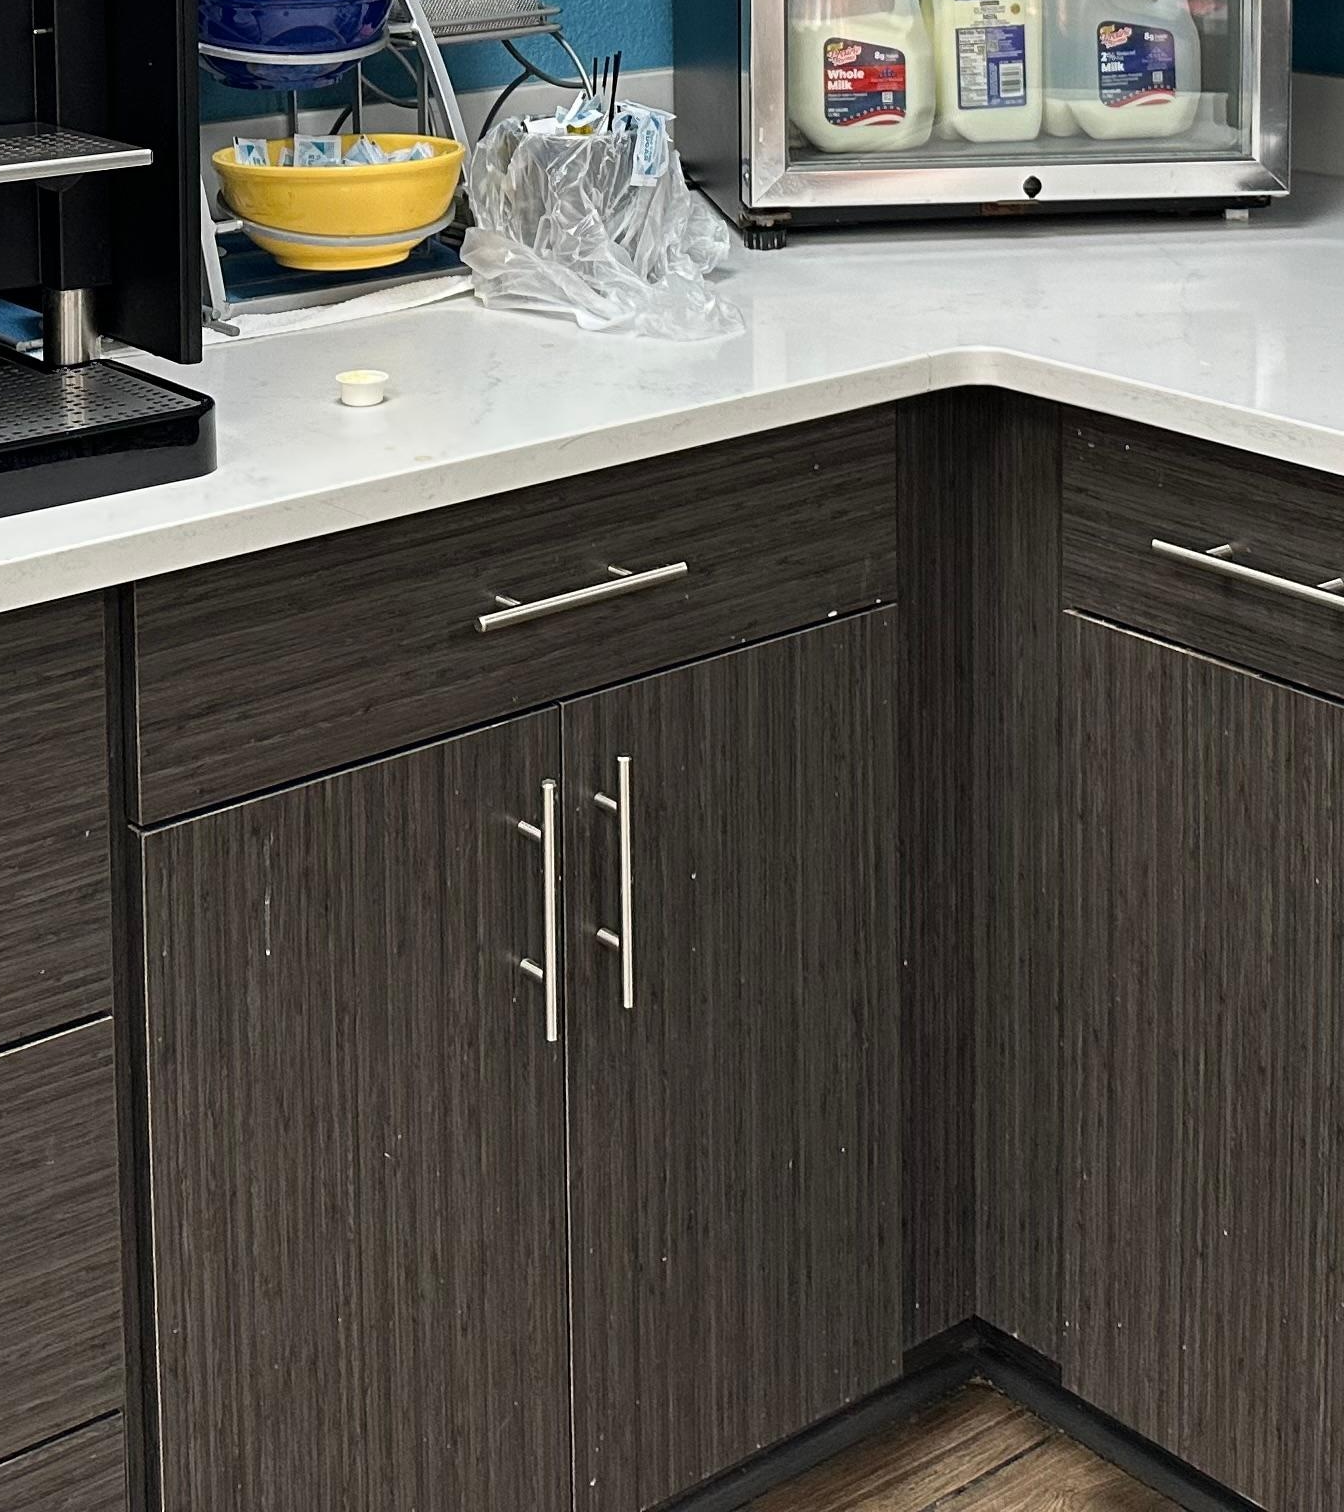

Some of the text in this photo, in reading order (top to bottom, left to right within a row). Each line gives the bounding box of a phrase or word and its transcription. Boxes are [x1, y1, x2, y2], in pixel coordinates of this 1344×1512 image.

[1101, 62, 1125, 73] Milk
[827, 69, 865, 80] Whole
[827, 80, 853, 91] Milk
